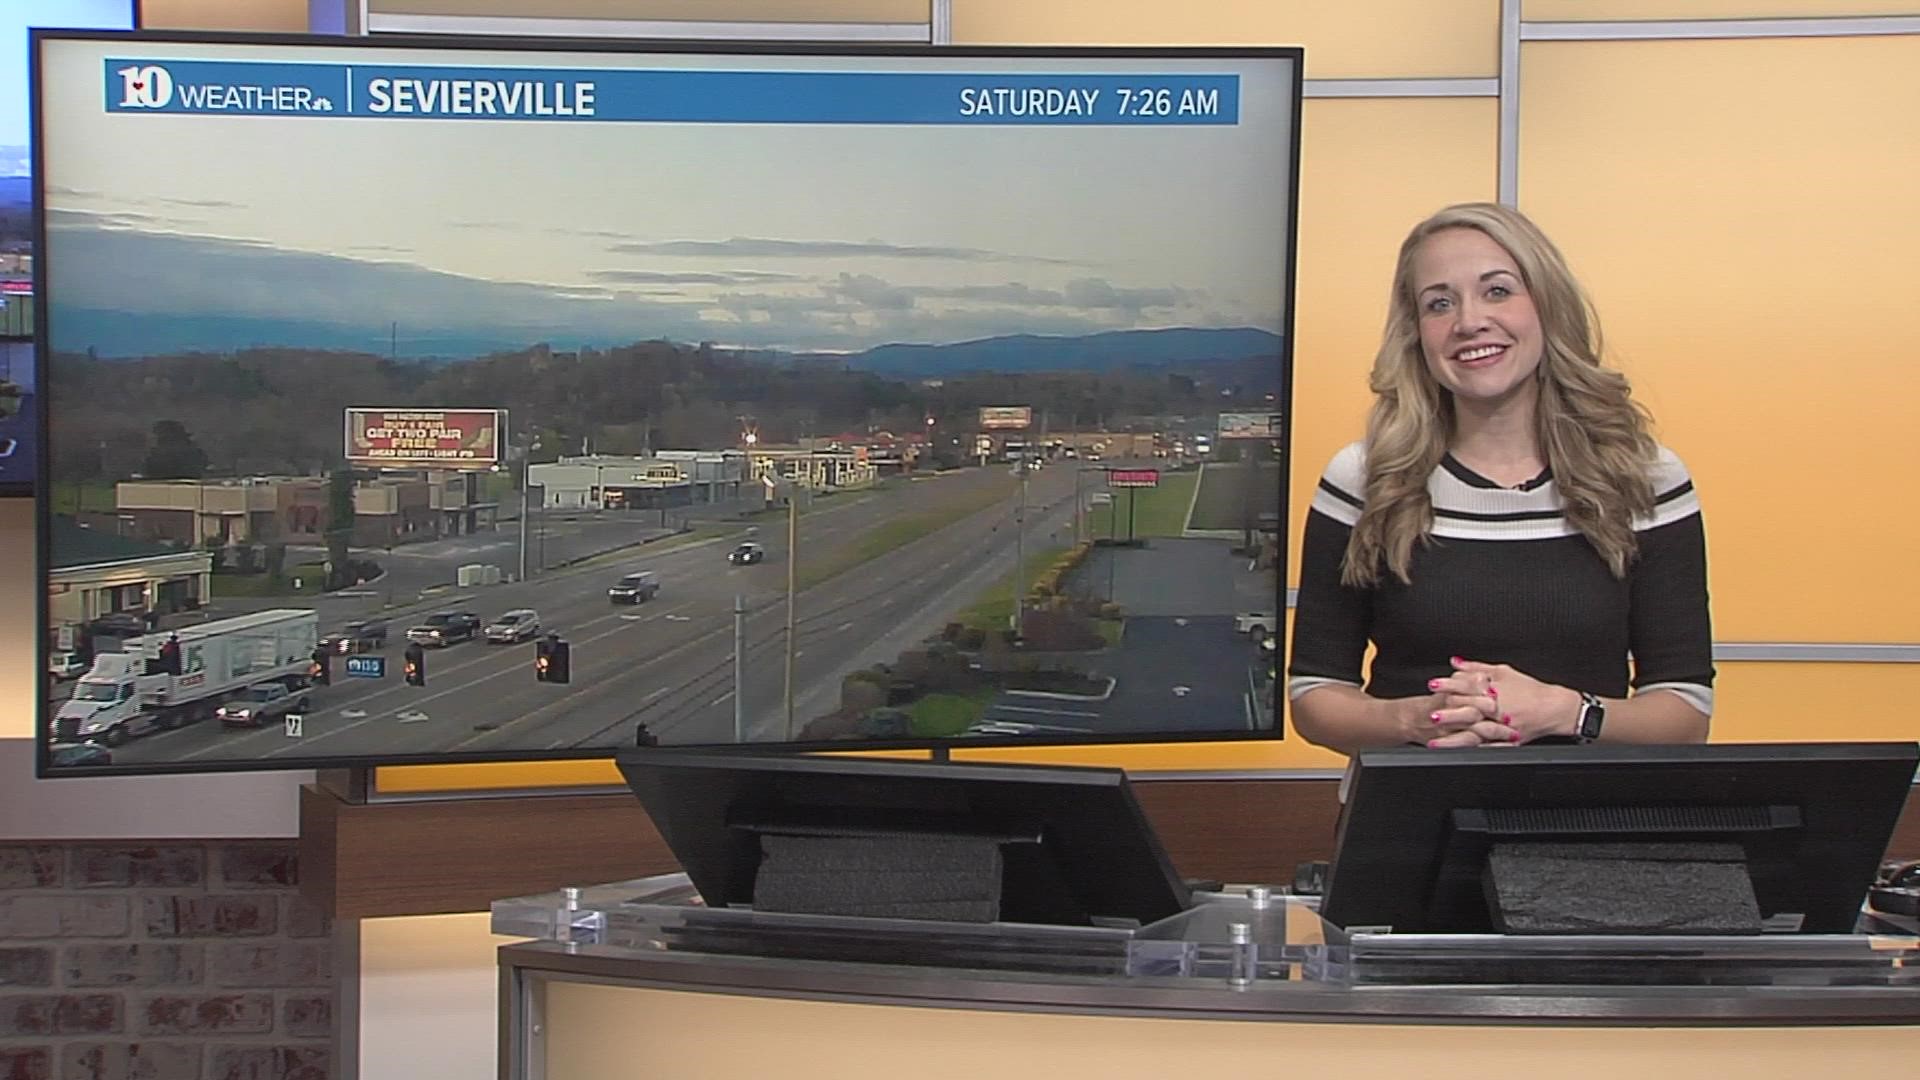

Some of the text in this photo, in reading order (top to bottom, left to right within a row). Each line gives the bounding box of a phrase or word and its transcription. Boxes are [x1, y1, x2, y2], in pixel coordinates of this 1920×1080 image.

[117, 65, 312, 110] 10 WEATHER
[368, 78, 596, 116] SEVIERVILLE
[959, 88, 1218, 116] SATURDAY 7:26 AM
[366, 428, 461, 439] GET TWO PAIR
[391, 438, 437, 449] FREE
